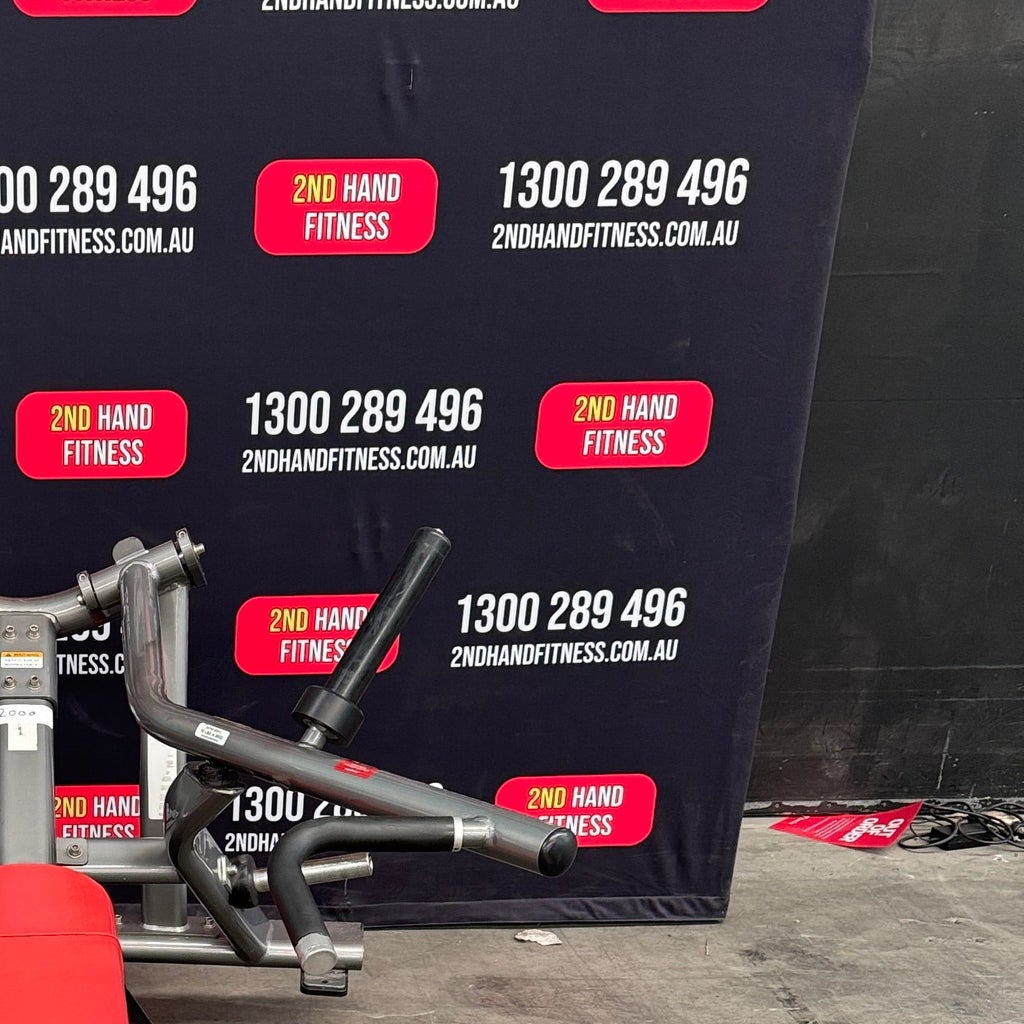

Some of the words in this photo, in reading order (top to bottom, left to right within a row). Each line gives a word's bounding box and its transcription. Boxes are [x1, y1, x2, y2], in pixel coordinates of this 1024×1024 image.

[49, 164, 117, 214] 289
[127, 163, 198, 213] 496
[292, 174, 336, 203] 2ND
[342, 173, 401, 203] HAND
[499, 159, 590, 209] 1300
[596, 158, 670, 208] 289
[676, 157, 750, 206] 496
[304, 211, 390, 241] FITNESS
[491, 219, 740, 250] 2NDHANDFITNESS.COM.AU
[51, 405, 91, 432] 2ND
[97, 403, 153, 431] HAND
[245, 390, 331, 436] 1300
[339, 388, 407, 434] 289
[414, 387, 484, 432] 496
[573, 395, 616, 422] 2ND
[621, 394, 678, 421] HAND
[63, 438, 144, 466] FITNESS
[582, 428, 666, 456] FITNESS
[241, 444, 477, 473] 2NDHANDFITNESS.COM.AU
[269, 608, 309, 632] 2ND
[457, 591, 540, 634] 1300
[547, 589, 614, 631] 289
[620, 586, 688, 628] 496
[279, 638, 353, 663] FITNES
[450, 638, 679, 668] 2NDHANDFITNESS.COM.AU
[527, 787, 567, 810] 2ND
[571, 785, 624, 808] HAND
